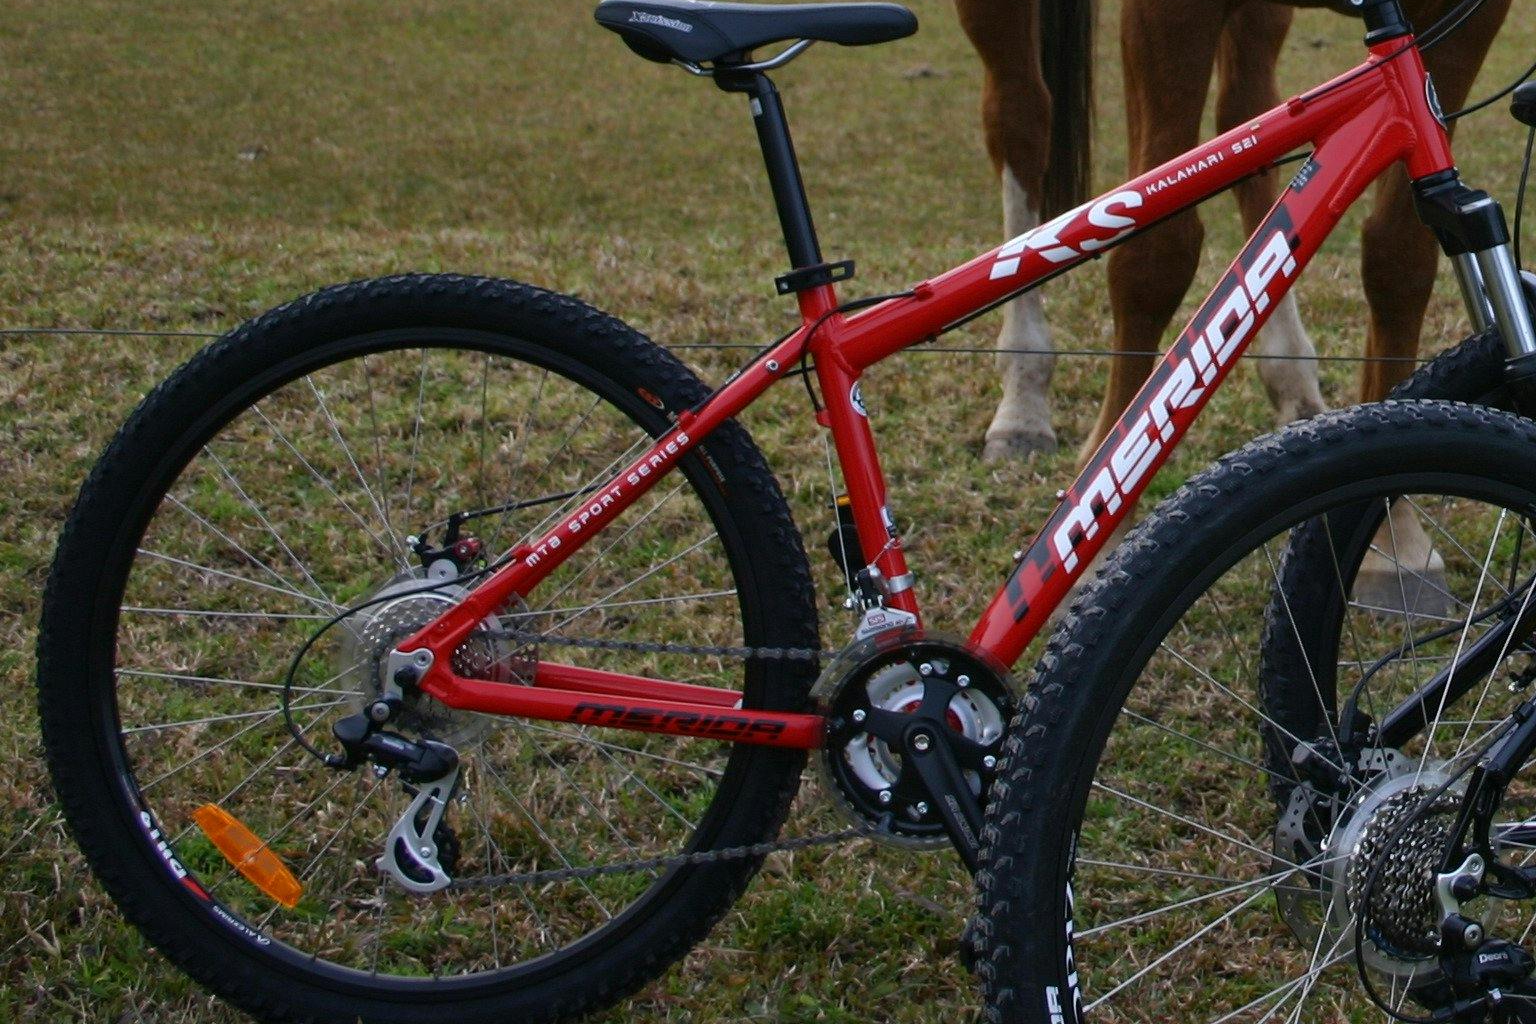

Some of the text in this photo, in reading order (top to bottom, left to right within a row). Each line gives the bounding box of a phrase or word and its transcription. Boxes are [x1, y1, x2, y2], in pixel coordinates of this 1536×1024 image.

[1145, 151, 1224, 196] KALAHARI
[1052, 230, 1298, 574] MERIDA
[525, 535, 562, 569] MTB
[568, 486, 623, 535] SPORT
[627, 432, 690, 487] SERIES
[568, 700, 788, 742] MERIDA
